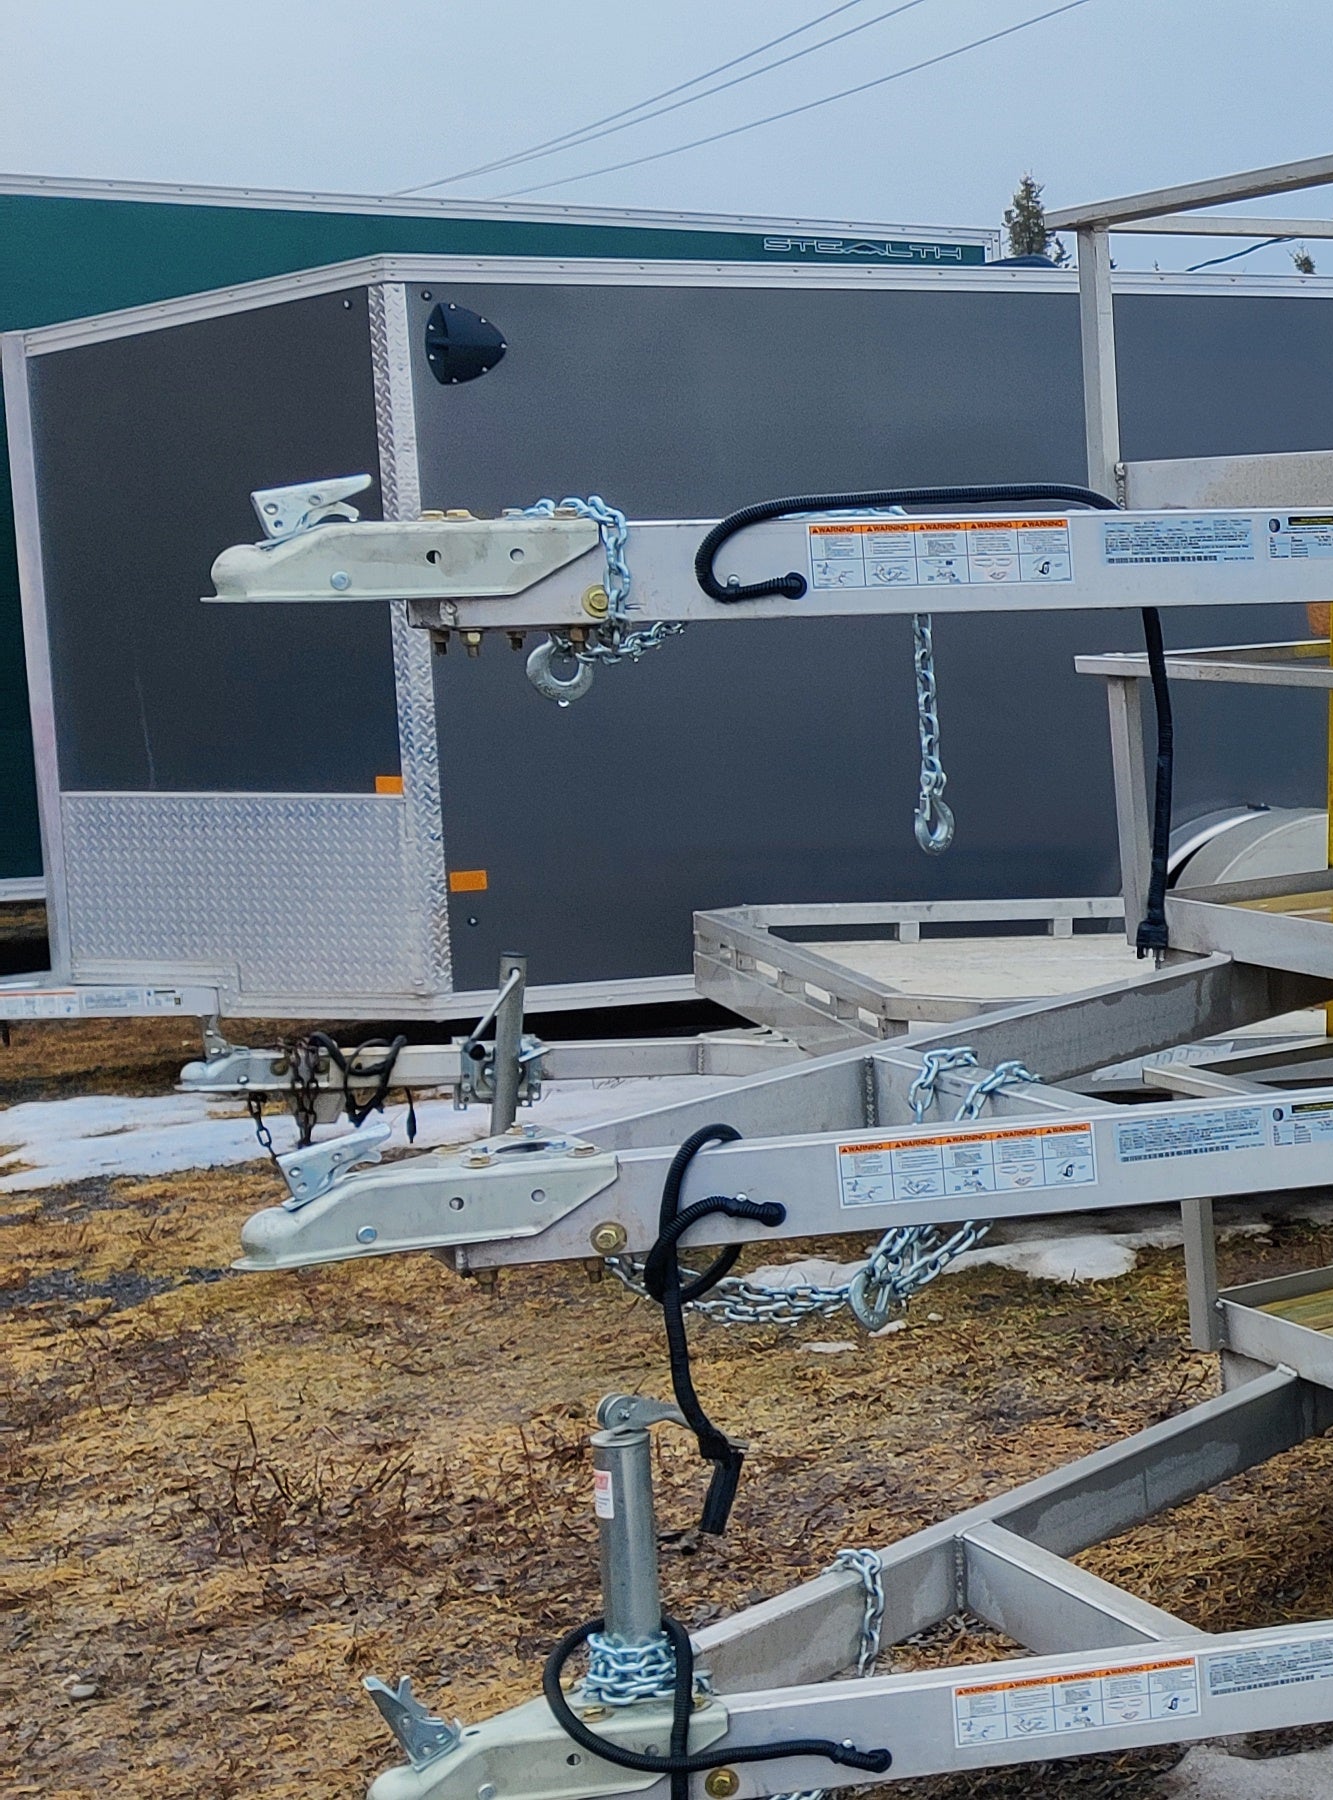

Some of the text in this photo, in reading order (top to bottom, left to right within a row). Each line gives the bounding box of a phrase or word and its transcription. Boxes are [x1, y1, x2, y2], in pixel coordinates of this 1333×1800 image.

[763, 236, 962, 260] STEALTH
[924, 522, 961, 530] WARNING
[977, 521, 1013, 529] WARNING
[1002, 1128, 1037, 1137] WARNING
[1051, 1123, 1087, 1133] WARNING
[900, 1138, 936, 1147] WARNING
[951, 1133, 987, 1142] WARNING
[848, 1143, 884, 1151] WARNING
[1158, 1658, 1192, 1669] WARNING
[1110, 1665, 1144, 1675] WARNING
[1063, 1671, 1096, 1681] WARNING
[1014, 1677, 1048, 1688] WARNING
[964, 1684, 999, 1694] WARNING
